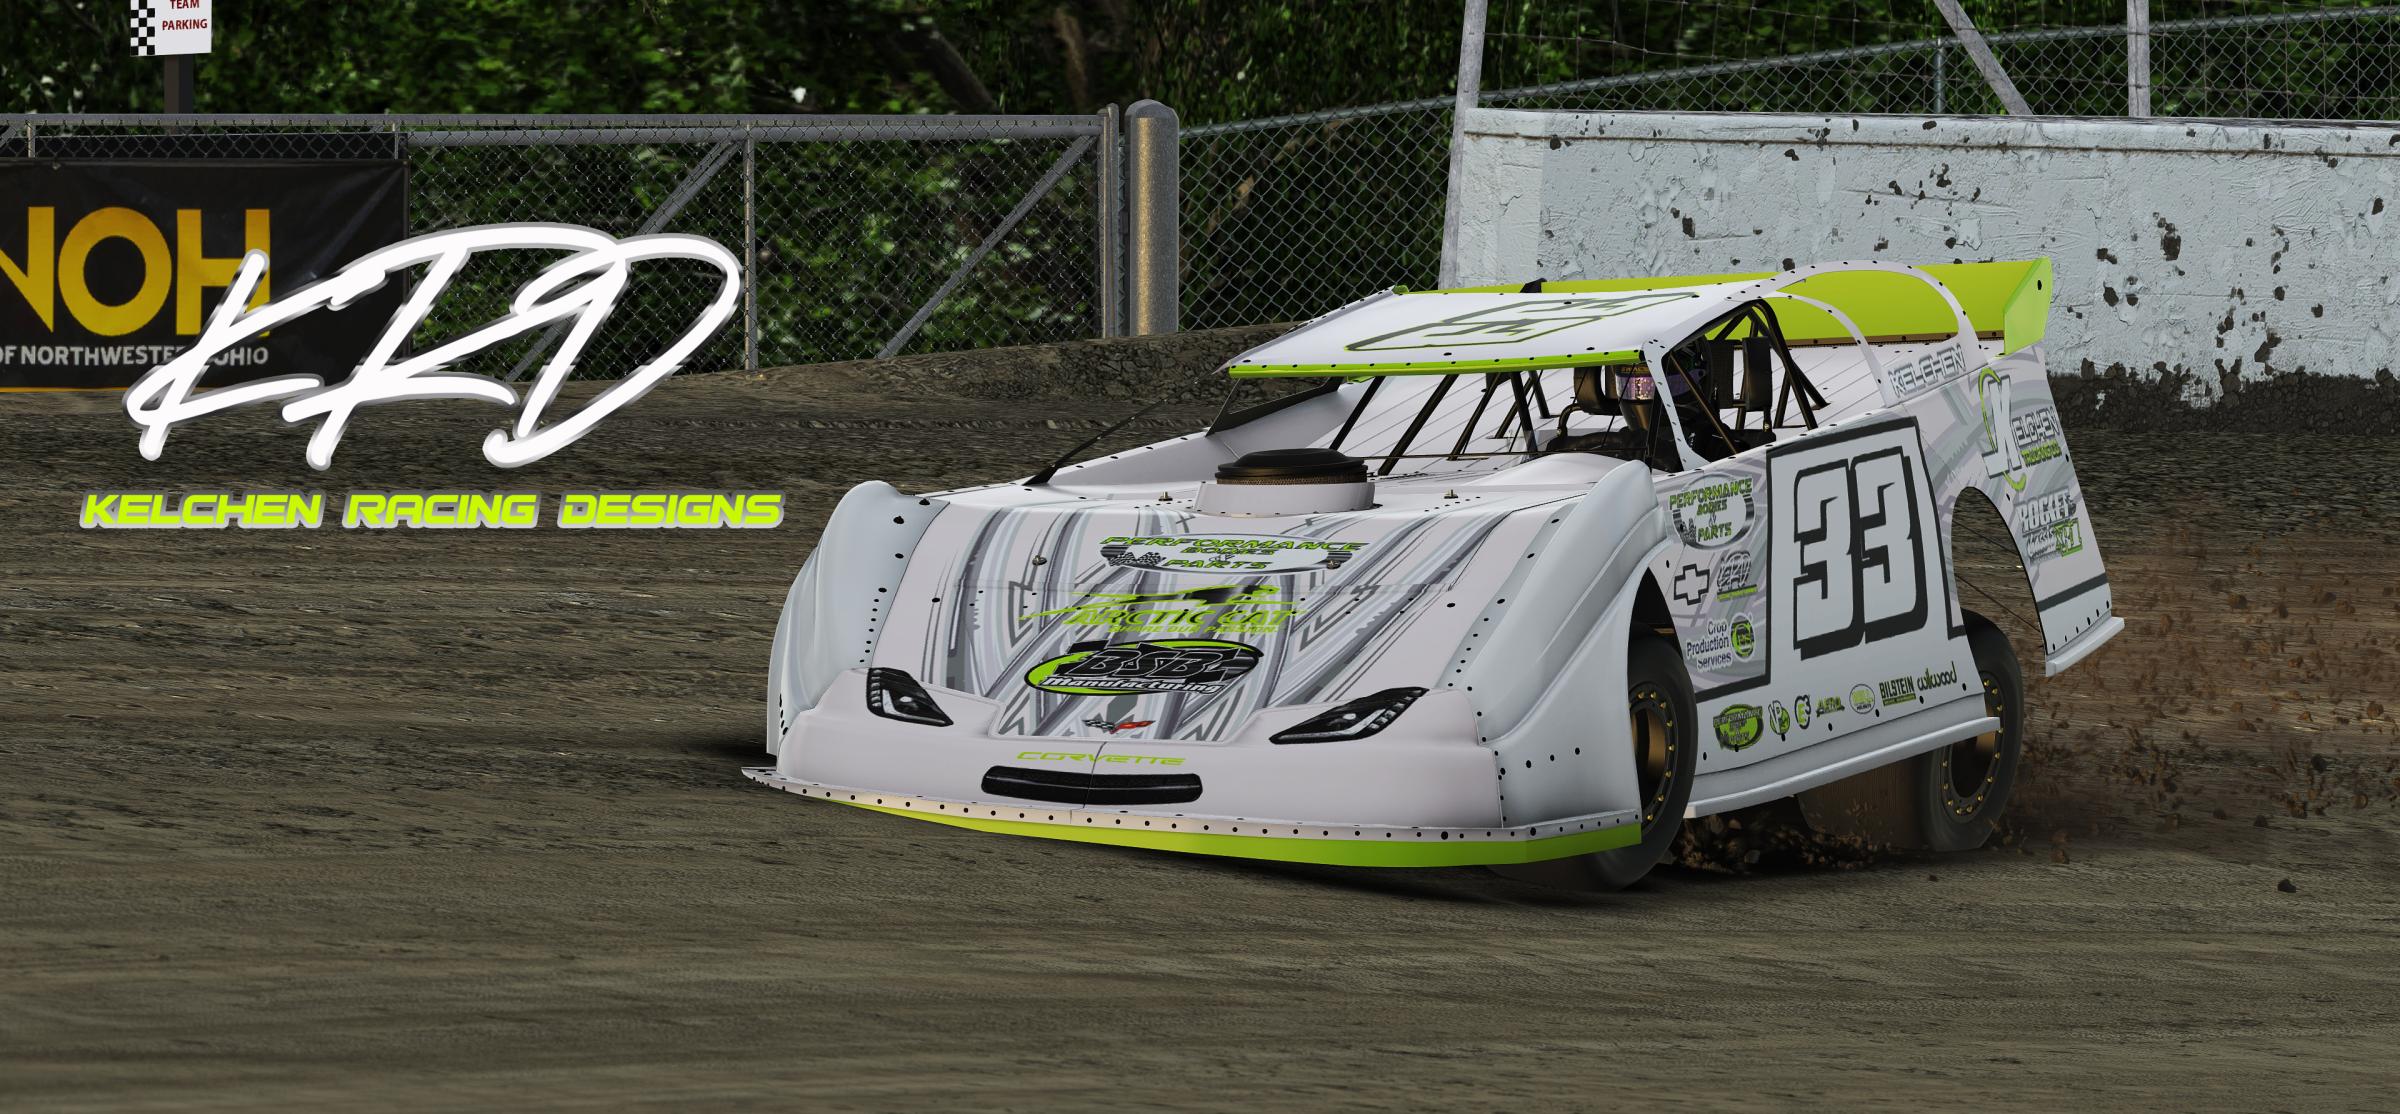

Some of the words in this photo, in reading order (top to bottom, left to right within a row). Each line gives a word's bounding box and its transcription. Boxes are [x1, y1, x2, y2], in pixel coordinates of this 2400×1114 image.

[170, 0, 200, 9] TEAM
[162, 19, 208, 31] PARKING
[1888, 343, 1966, 398] KELCHEN
[1669, 478, 1753, 511] PERFORMANCE
[1697, 522, 1732, 542] PARTS
[1100, 536, 1370, 552] PERFORMANCE
[1793, 446, 1929, 660] 33
[1162, 559, 1273, 570] PARTS
[1062, 608, 1213, 625] ARCTIC
[1214, 608, 1294, 625] CAT
[1707, 621, 1728, 636] Crop
[1687, 636, 1730, 656] Production
[1698, 652, 1732, 669] Services
[1041, 676, 1226, 694] Manufacturing
[1879, 676, 1915, 699] BILSTEIN
[1016, 751, 1187, 766] CORVETTE
